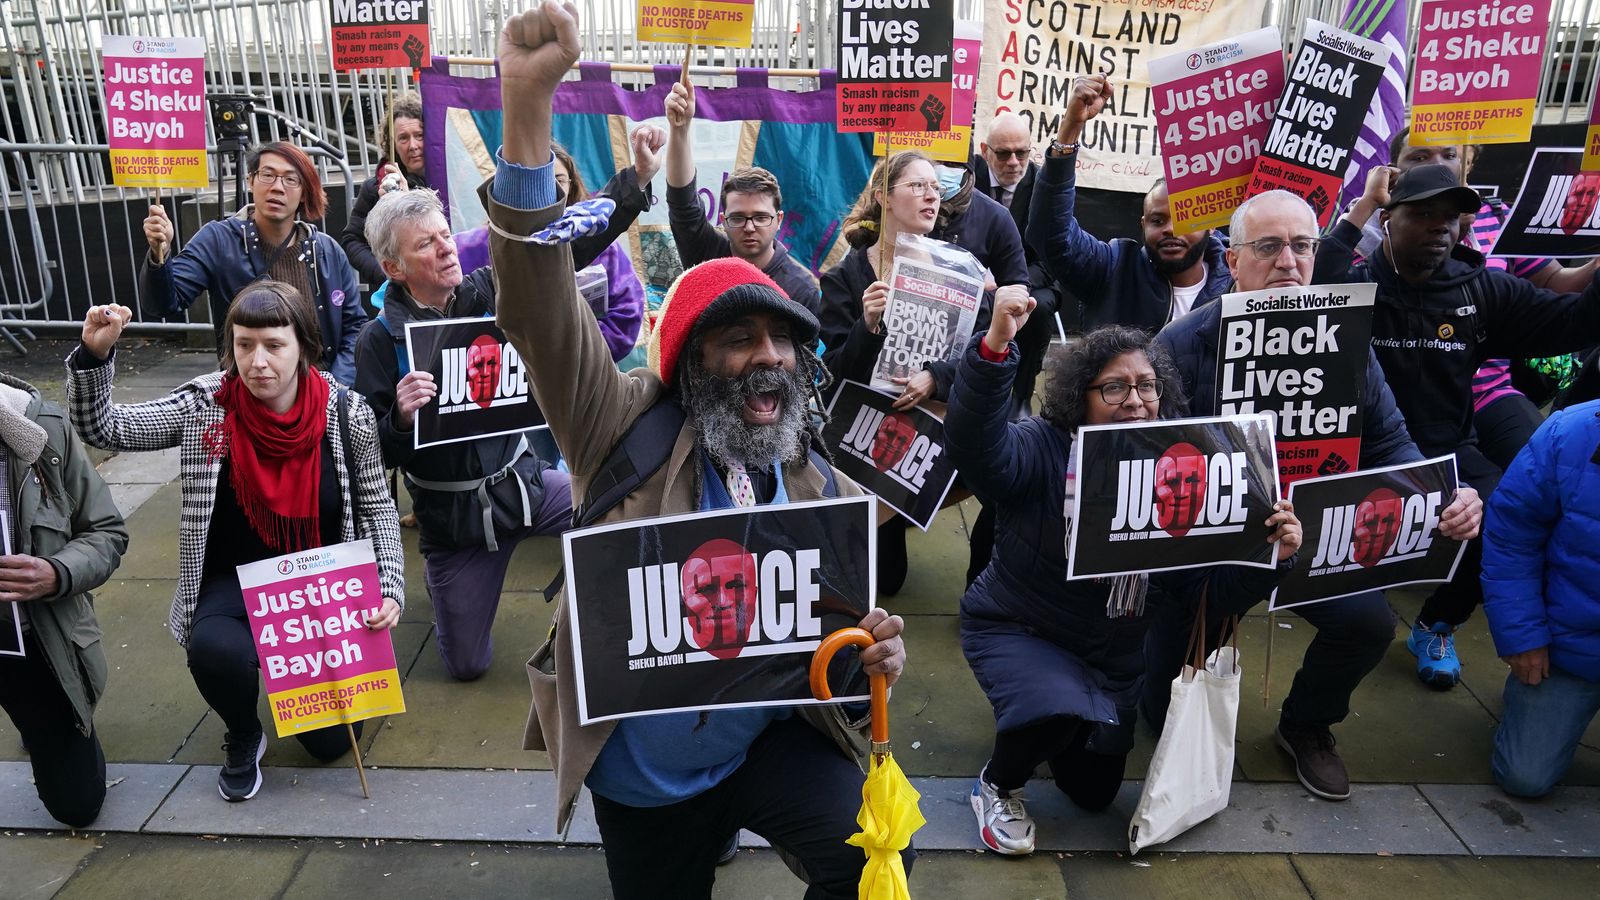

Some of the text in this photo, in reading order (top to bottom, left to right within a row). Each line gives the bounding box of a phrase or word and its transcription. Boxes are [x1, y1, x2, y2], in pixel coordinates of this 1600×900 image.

[333, 0, 424, 24] Matter
[641, 17, 709, 30] IN CUSTODY
[642, 6, 744, 22] NO MORE DEATHS
[1005, 0, 1182, 46] SCOTLAND
[1424, 0, 1534, 31] Justice
[335, 28, 401, 41] Smash racism
[842, 11, 920, 44] Lives
[336, 43, 399, 54] by any means
[1001, 31, 1140, 80] AGAINST
[1204, 43, 1239, 57] STAND UP
[1216, 49, 1244, 62] RACISM
[1421, 31, 1540, 61] 4 Sheku
[337, 55, 384, 65] necessary
[841, 46, 948, 79] Matter
[1292, 45, 1359, 98] Black
[108, 61, 194, 85] Justice
[1419, 63, 1510, 96] Bayoh
[110, 89, 201, 112] 4 Sheku
[842, 87, 920, 99] Smash racism
[1160, 67, 1268, 116] Justice
[842, 102, 916, 115] by any means
[1277, 82, 1337, 131] Lives
[1415, 107, 1524, 123] NO MORE DEATHS
[112, 117, 184, 143] Bayoh
[842, 116, 896, 128] necessary
[1164, 98, 1279, 147] 4 Sheku
[1414, 120, 1485, 133] IN CUSTODY
[890, 137, 933, 147] CUSTODY
[924, 131, 962, 141] DEATHS
[1264, 118, 1349, 171] Matter
[114, 156, 199, 166] NO MORE DEATHS
[1112, 160, 1150, 176] civil
[1168, 136, 1260, 180] Bayoh
[115, 166, 173, 175] IN CUSTODY
[1257, 160, 1313, 186] Smash racism
[1252, 175, 1263, 188] by
[1262, 180, 1276, 191] any
[1174, 198, 1193, 211] NO
[1195, 187, 1235, 206] MORE
[1176, 209, 1190, 222] IN
[903, 278, 976, 308] Socialist Worker
[1245, 292, 1351, 313] Socialist Worker
[891, 299, 948, 327] BRING
[887, 315, 948, 343] DOWN
[1225, 314, 1341, 360] Black
[884, 331, 949, 359] FILTHY
[1402, 339, 1416, 348] for
[1222, 360, 1324, 400] Lives
[1277, 446, 1319, 461] acism
[1279, 463, 1313, 476] eans
[1111, 451, 1248, 531] JUSTICE
[1108, 531, 1149, 542] SHEKU BAYOH
[1311, 491, 1441, 569] JUSTICE
[295, 552, 331, 565] STAND UP
[308, 558, 336, 569] RACISM
[253, 577, 364, 618] Justice
[627, 548, 822, 656] JUSTICE
[259, 606, 379, 647] 4 Sheku
[265, 639, 363, 680] Bayoh
[628, 654, 684, 671] SHEKU BAYOH
[276, 678, 389, 711] NO MORE DEATHS
[279, 709, 293, 722] IN
[295, 697, 353, 718] CUSTODY
